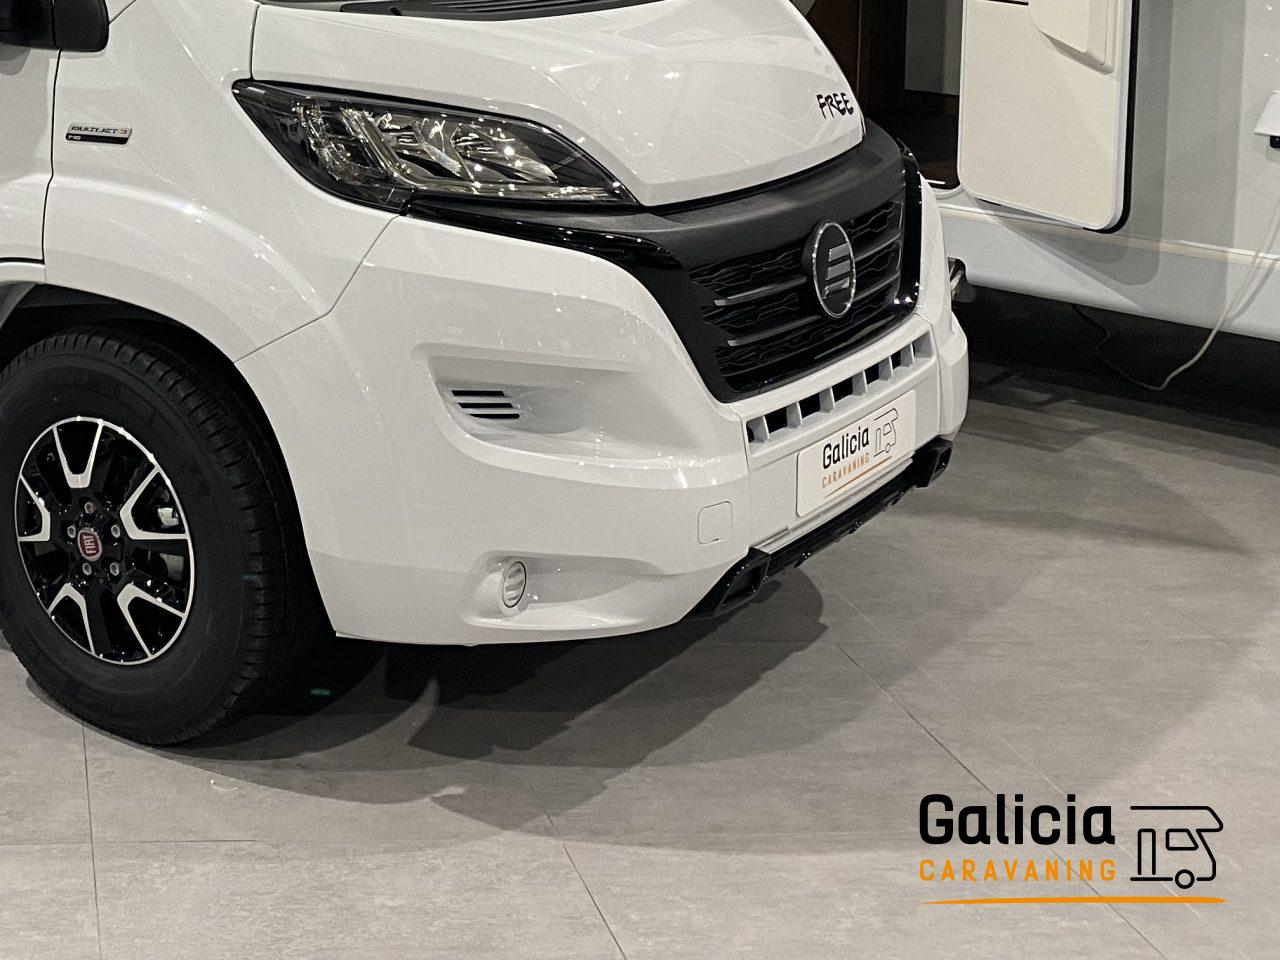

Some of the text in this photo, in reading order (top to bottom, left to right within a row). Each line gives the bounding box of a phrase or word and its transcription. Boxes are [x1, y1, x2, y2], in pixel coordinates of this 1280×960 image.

[816, 92, 854, 119] FREE
[822, 426, 869, 469] Galicia
[822, 452, 870, 488] CARAVANING
[82, 534, 97, 554] FIAT
